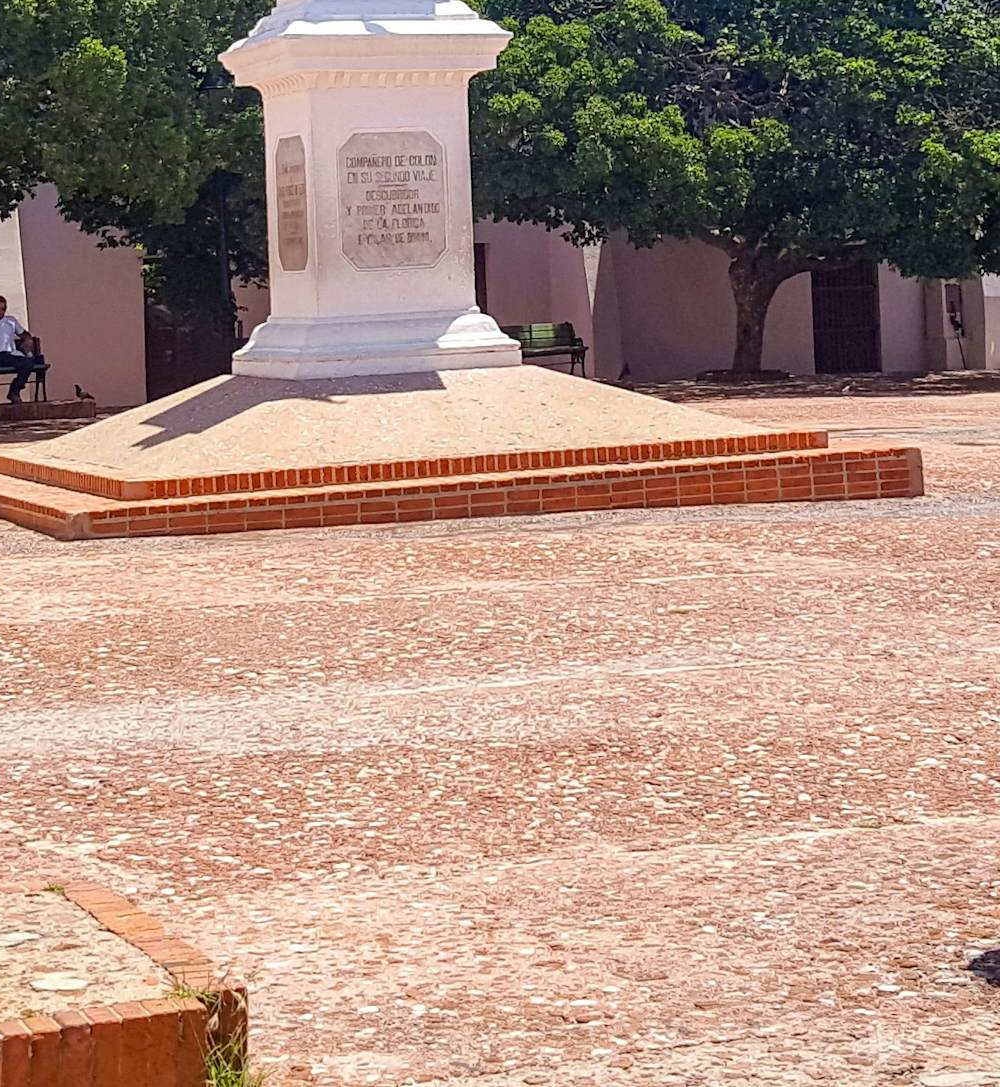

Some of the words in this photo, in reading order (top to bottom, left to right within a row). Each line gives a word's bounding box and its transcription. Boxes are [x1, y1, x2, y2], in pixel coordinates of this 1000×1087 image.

[394, 155, 407, 167] DE
[361, 171, 372, 183] SU
[346, 206, 352, 216] Y
